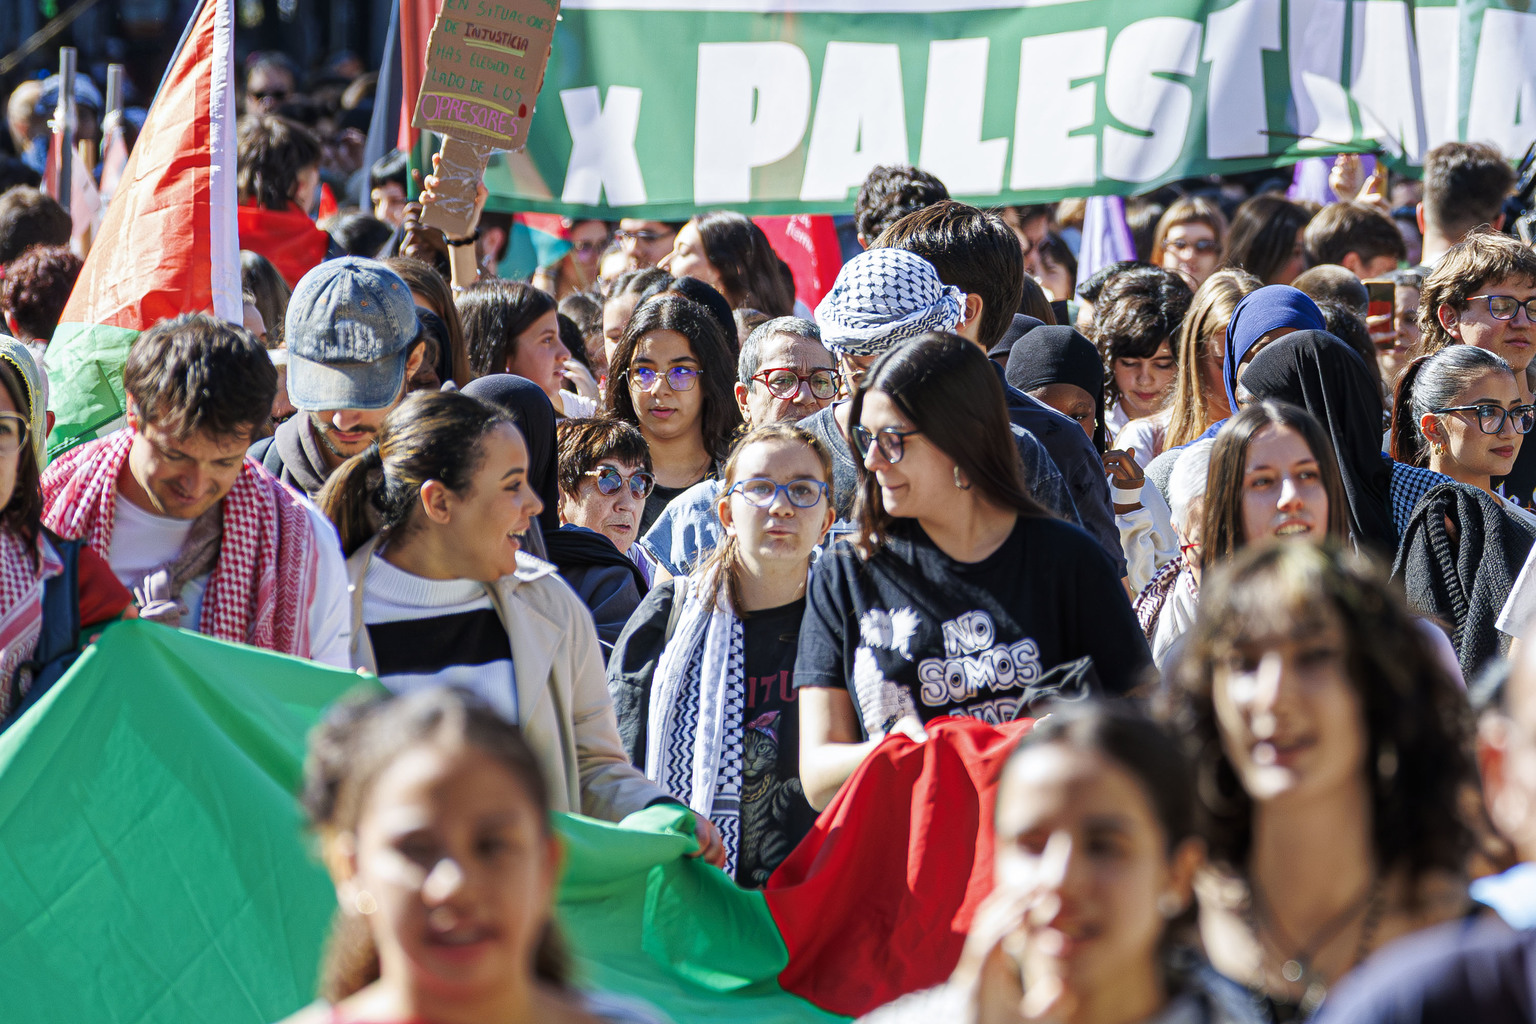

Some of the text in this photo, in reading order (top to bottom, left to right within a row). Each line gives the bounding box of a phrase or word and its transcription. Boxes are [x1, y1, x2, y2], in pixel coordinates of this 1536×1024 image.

[444, 18, 460, 35] DE
[436, 44, 463, 63] HAS
[513, 66, 527, 81] EL
[432, 66, 522, 104] LADO DE LOS
[420, 94, 521, 138] OPRESORES
[942, 609, 997, 658] NO
[918, 638, 1042, 708] SOMOS
